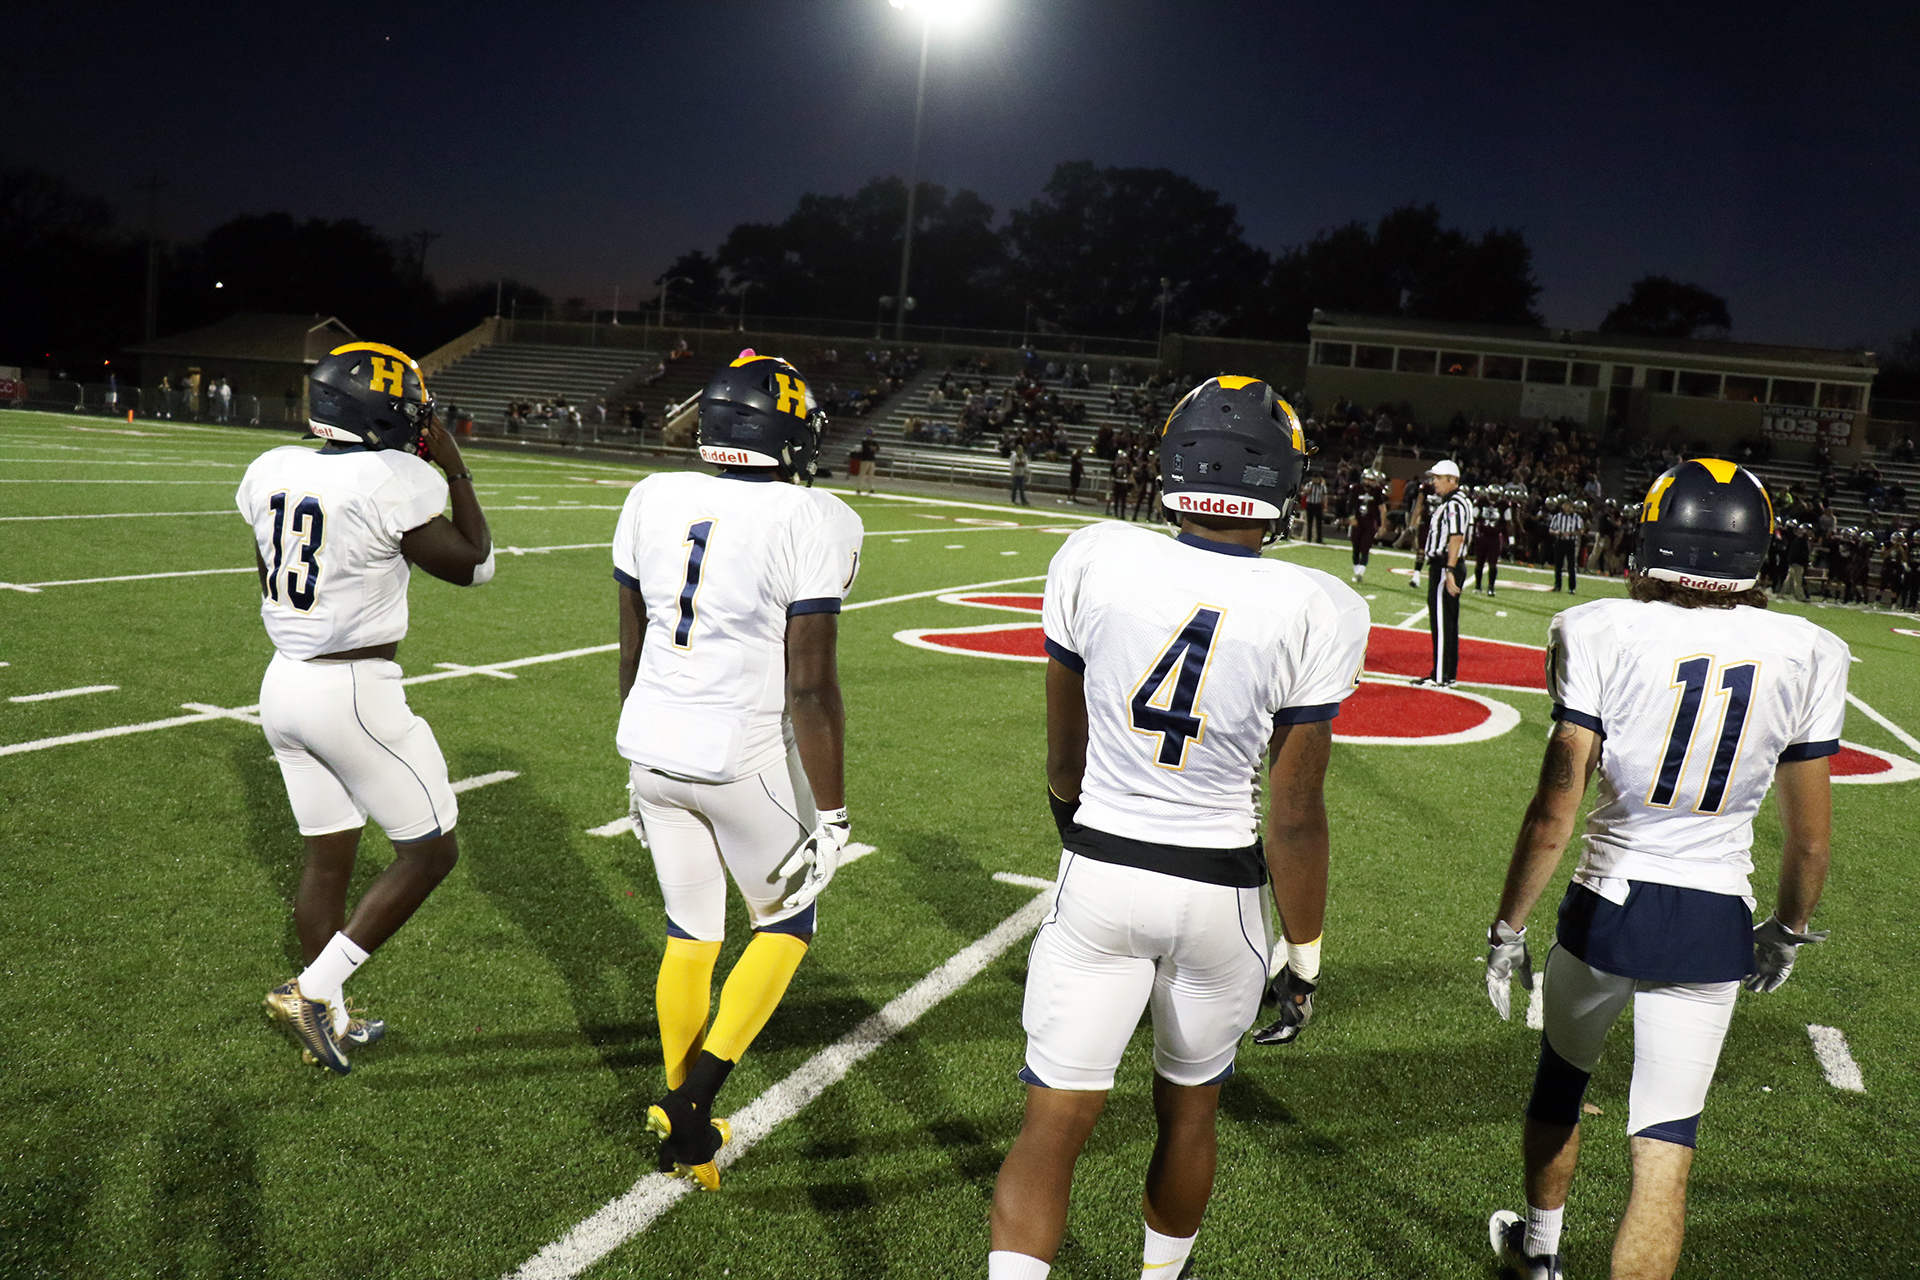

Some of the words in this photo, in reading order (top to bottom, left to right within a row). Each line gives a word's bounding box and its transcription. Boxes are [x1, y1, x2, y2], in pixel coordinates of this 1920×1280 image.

[369, 356, 405, 398] H
[774, 372, 806, 420] H
[1762, 416, 1851, 437] 103.9
[702, 449, 749, 464] Riddell
[1178, 496, 1254, 517] Riddell
[266, 488, 328, 615] 13
[671, 516, 719, 651] 1
[1679, 576, 1739, 592] Riddell
[1126, 602, 1228, 772] 4
[1643, 653, 1762, 816] 11
